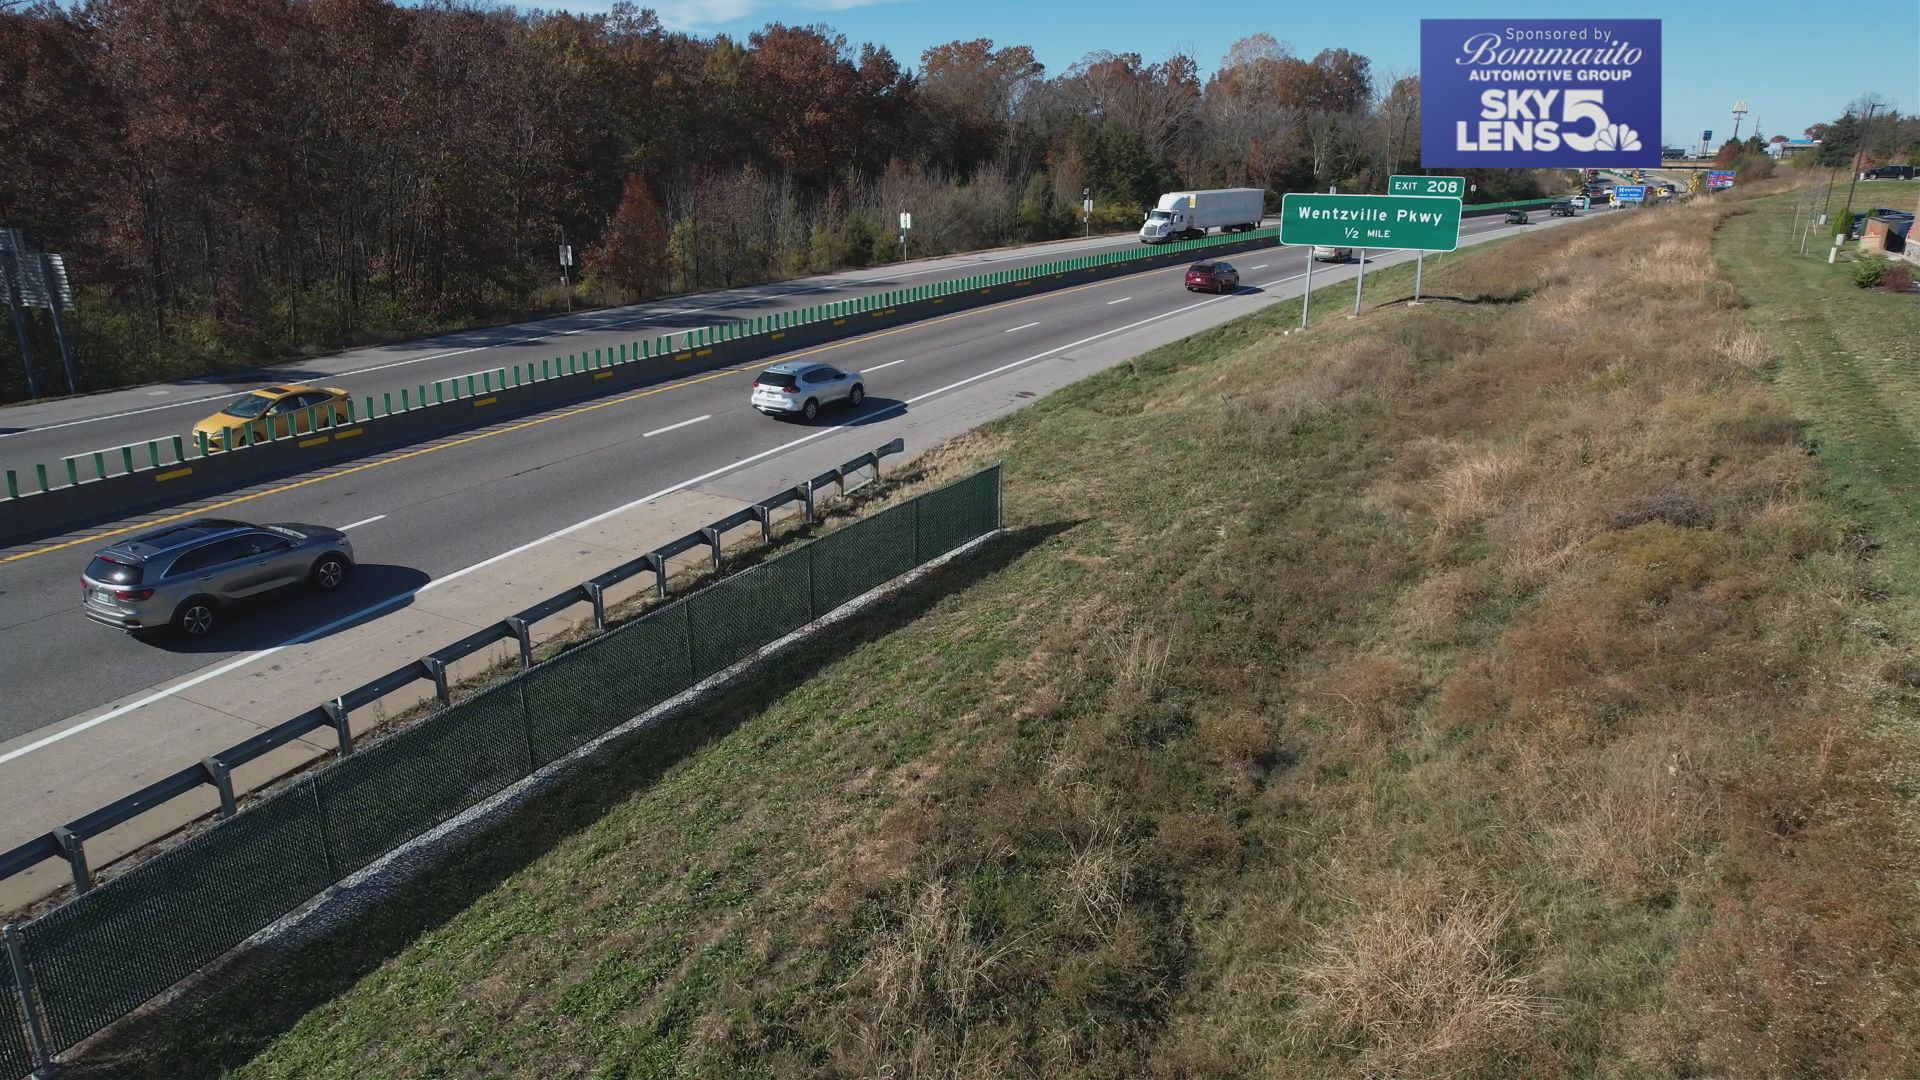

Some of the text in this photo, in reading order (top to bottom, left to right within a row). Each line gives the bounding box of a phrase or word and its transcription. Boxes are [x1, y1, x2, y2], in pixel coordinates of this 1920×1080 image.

[1395, 181, 1457, 193] EXIT 208
[1299, 206, 1442, 226] Wentzville Pkwy
[1367, 229, 1391, 238] MILE
